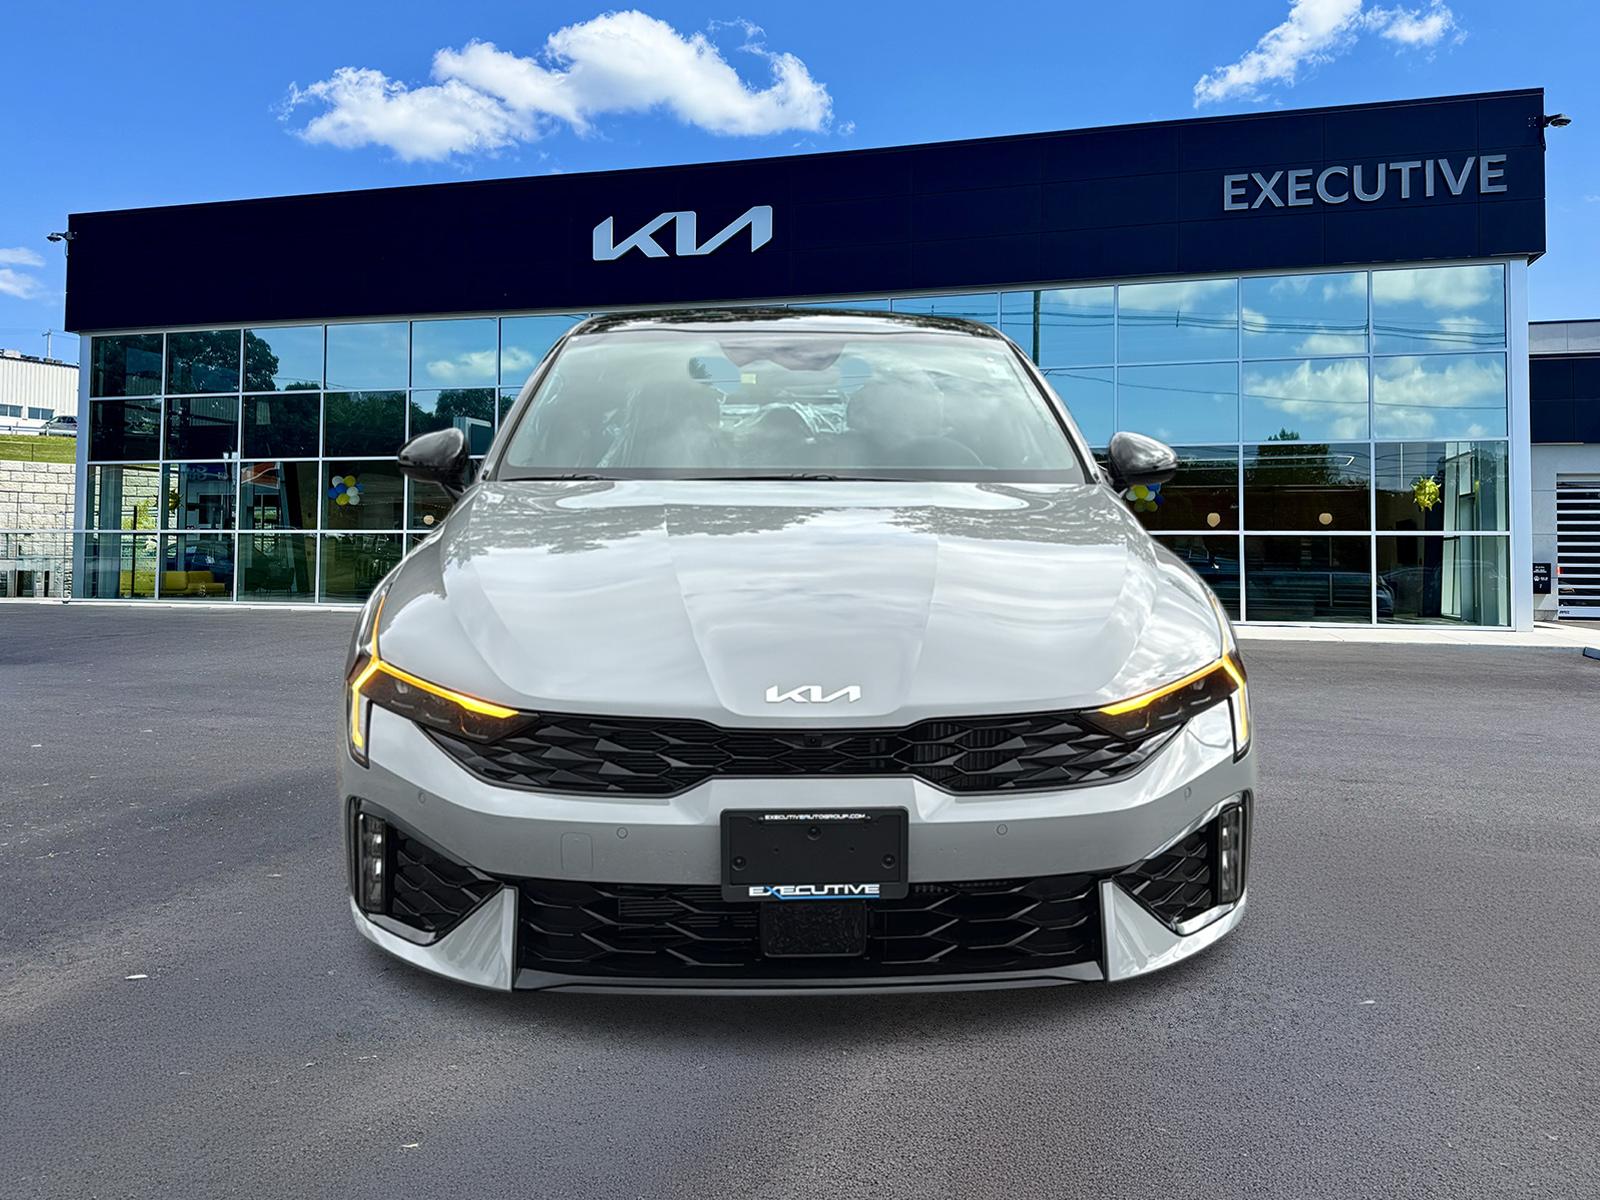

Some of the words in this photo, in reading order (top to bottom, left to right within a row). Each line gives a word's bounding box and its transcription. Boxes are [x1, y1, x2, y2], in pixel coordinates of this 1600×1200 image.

[1223, 154, 1508, 211] EXECUTIVE
[593, 205, 773, 261] KIA
[765, 685, 862, 704] KIA
[748, 883, 880, 899] EXECUTIVE
